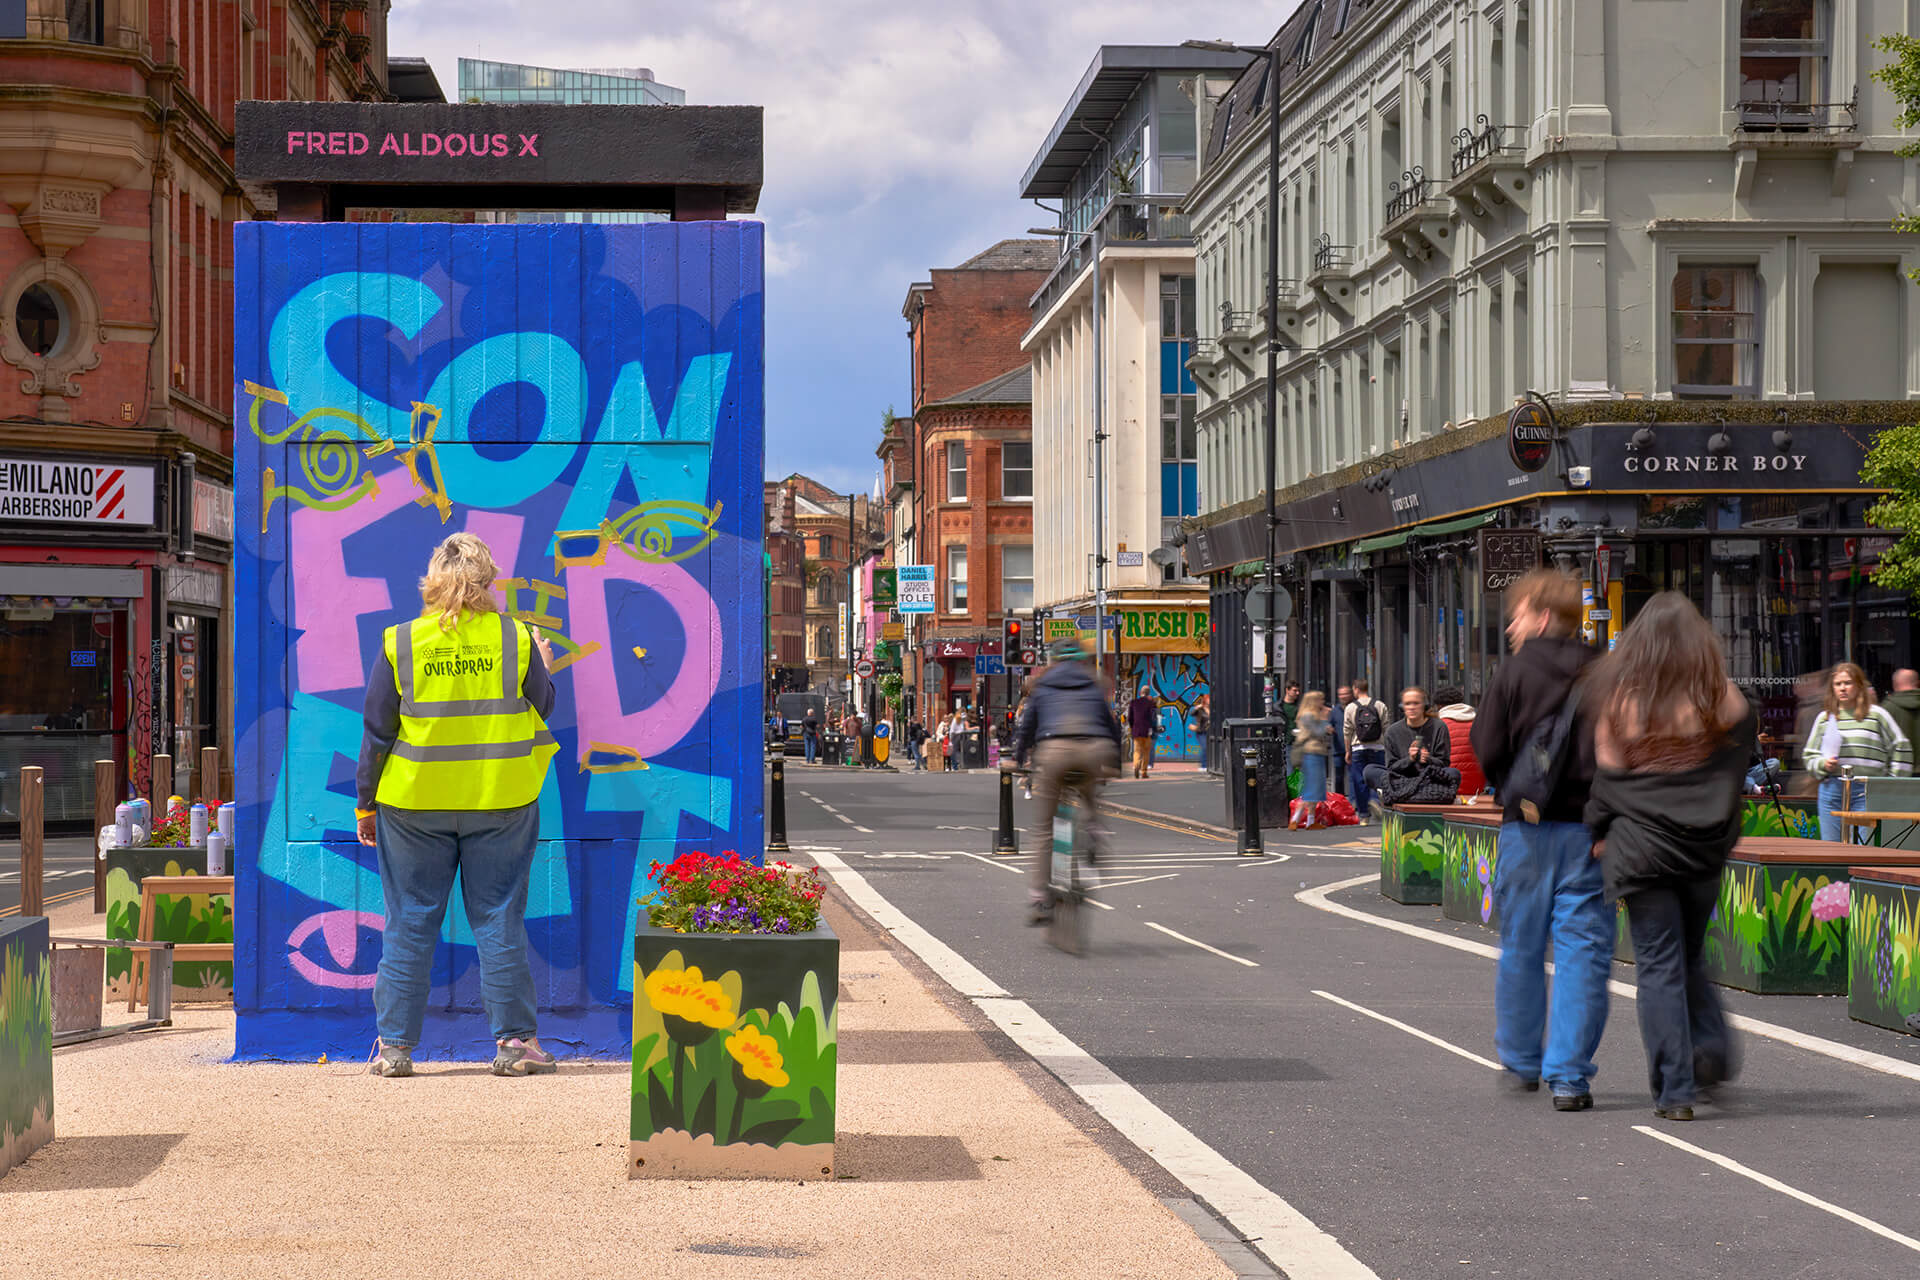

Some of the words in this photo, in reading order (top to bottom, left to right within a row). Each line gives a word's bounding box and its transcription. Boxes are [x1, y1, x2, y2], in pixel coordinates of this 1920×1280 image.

[287, 131, 369, 156] FRED
[379, 132, 509, 158] ALDOUS
[518, 133, 539, 157] X
[268, 271, 733, 557] CON
[1514, 425, 1553, 441] GUINNE
[1623, 455, 1739, 473] CORNER
[1752, 455, 1807, 472] BOY
[10, 463, 94, 496] MILANO
[0, 496, 93, 519] ARBERSHOP
[1486, 536, 1536, 553] OPEN
[1488, 553, 1533, 569] LATE
[899, 593, 914, 603] TO
[916, 593, 935, 603] LET
[424, 657, 493, 676] OVERSPRAY
[1750, 677, 1766, 685] FOR
